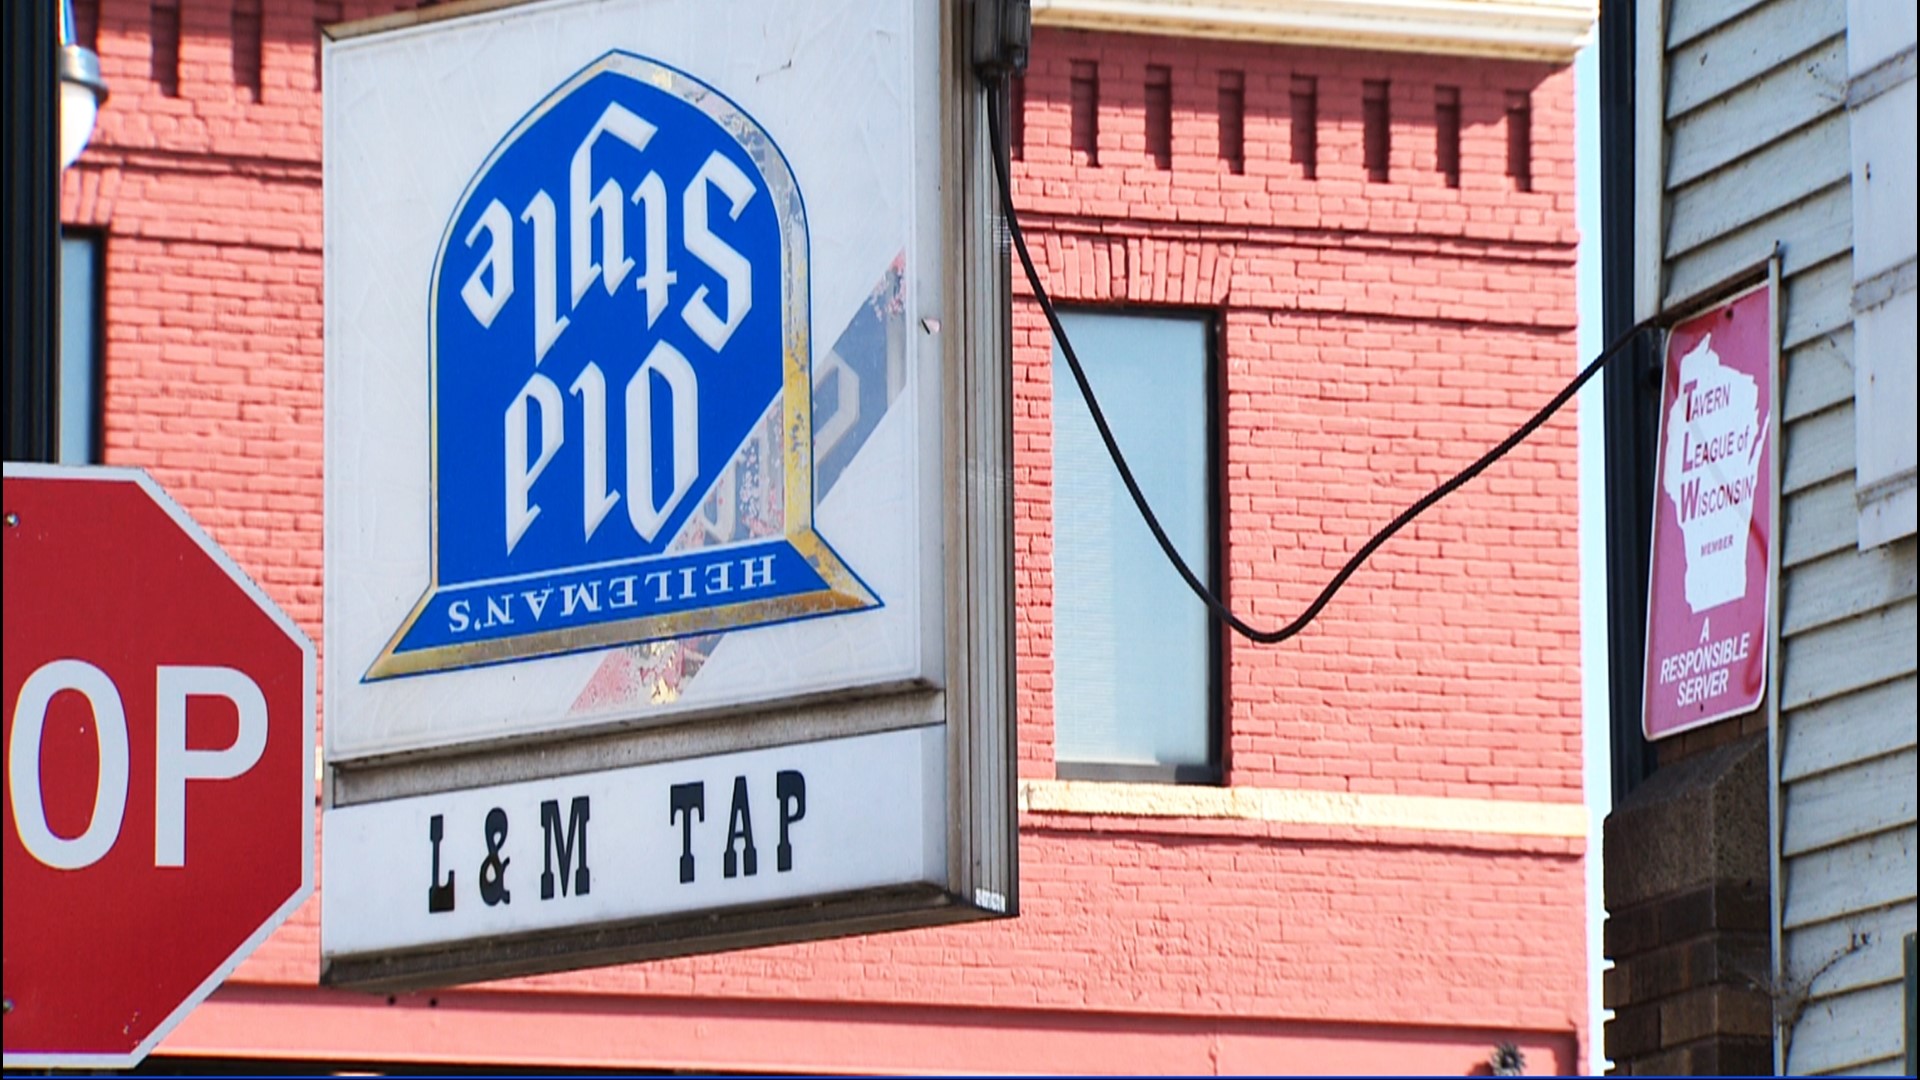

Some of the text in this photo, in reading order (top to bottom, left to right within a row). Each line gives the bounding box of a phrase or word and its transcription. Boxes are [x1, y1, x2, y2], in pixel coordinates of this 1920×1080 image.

[461, 101, 757, 368] Style
[1682, 379, 1731, 423] TAVERN
[504, 338, 699, 557] Old
[1681, 424, 1750, 473] LEAGUE of
[1680, 475, 1754, 523] WISCONSIN
[1700, 534, 1734, 557] MEMBER
[447, 554, 777, 633] HEILEMAN'S
[1700, 616, 1710, 644] A
[1660, 632, 1750, 685] RESPONSIBLE
[1677, 668, 1729, 707] SERVER
[670, 769, 807, 884] TAP
